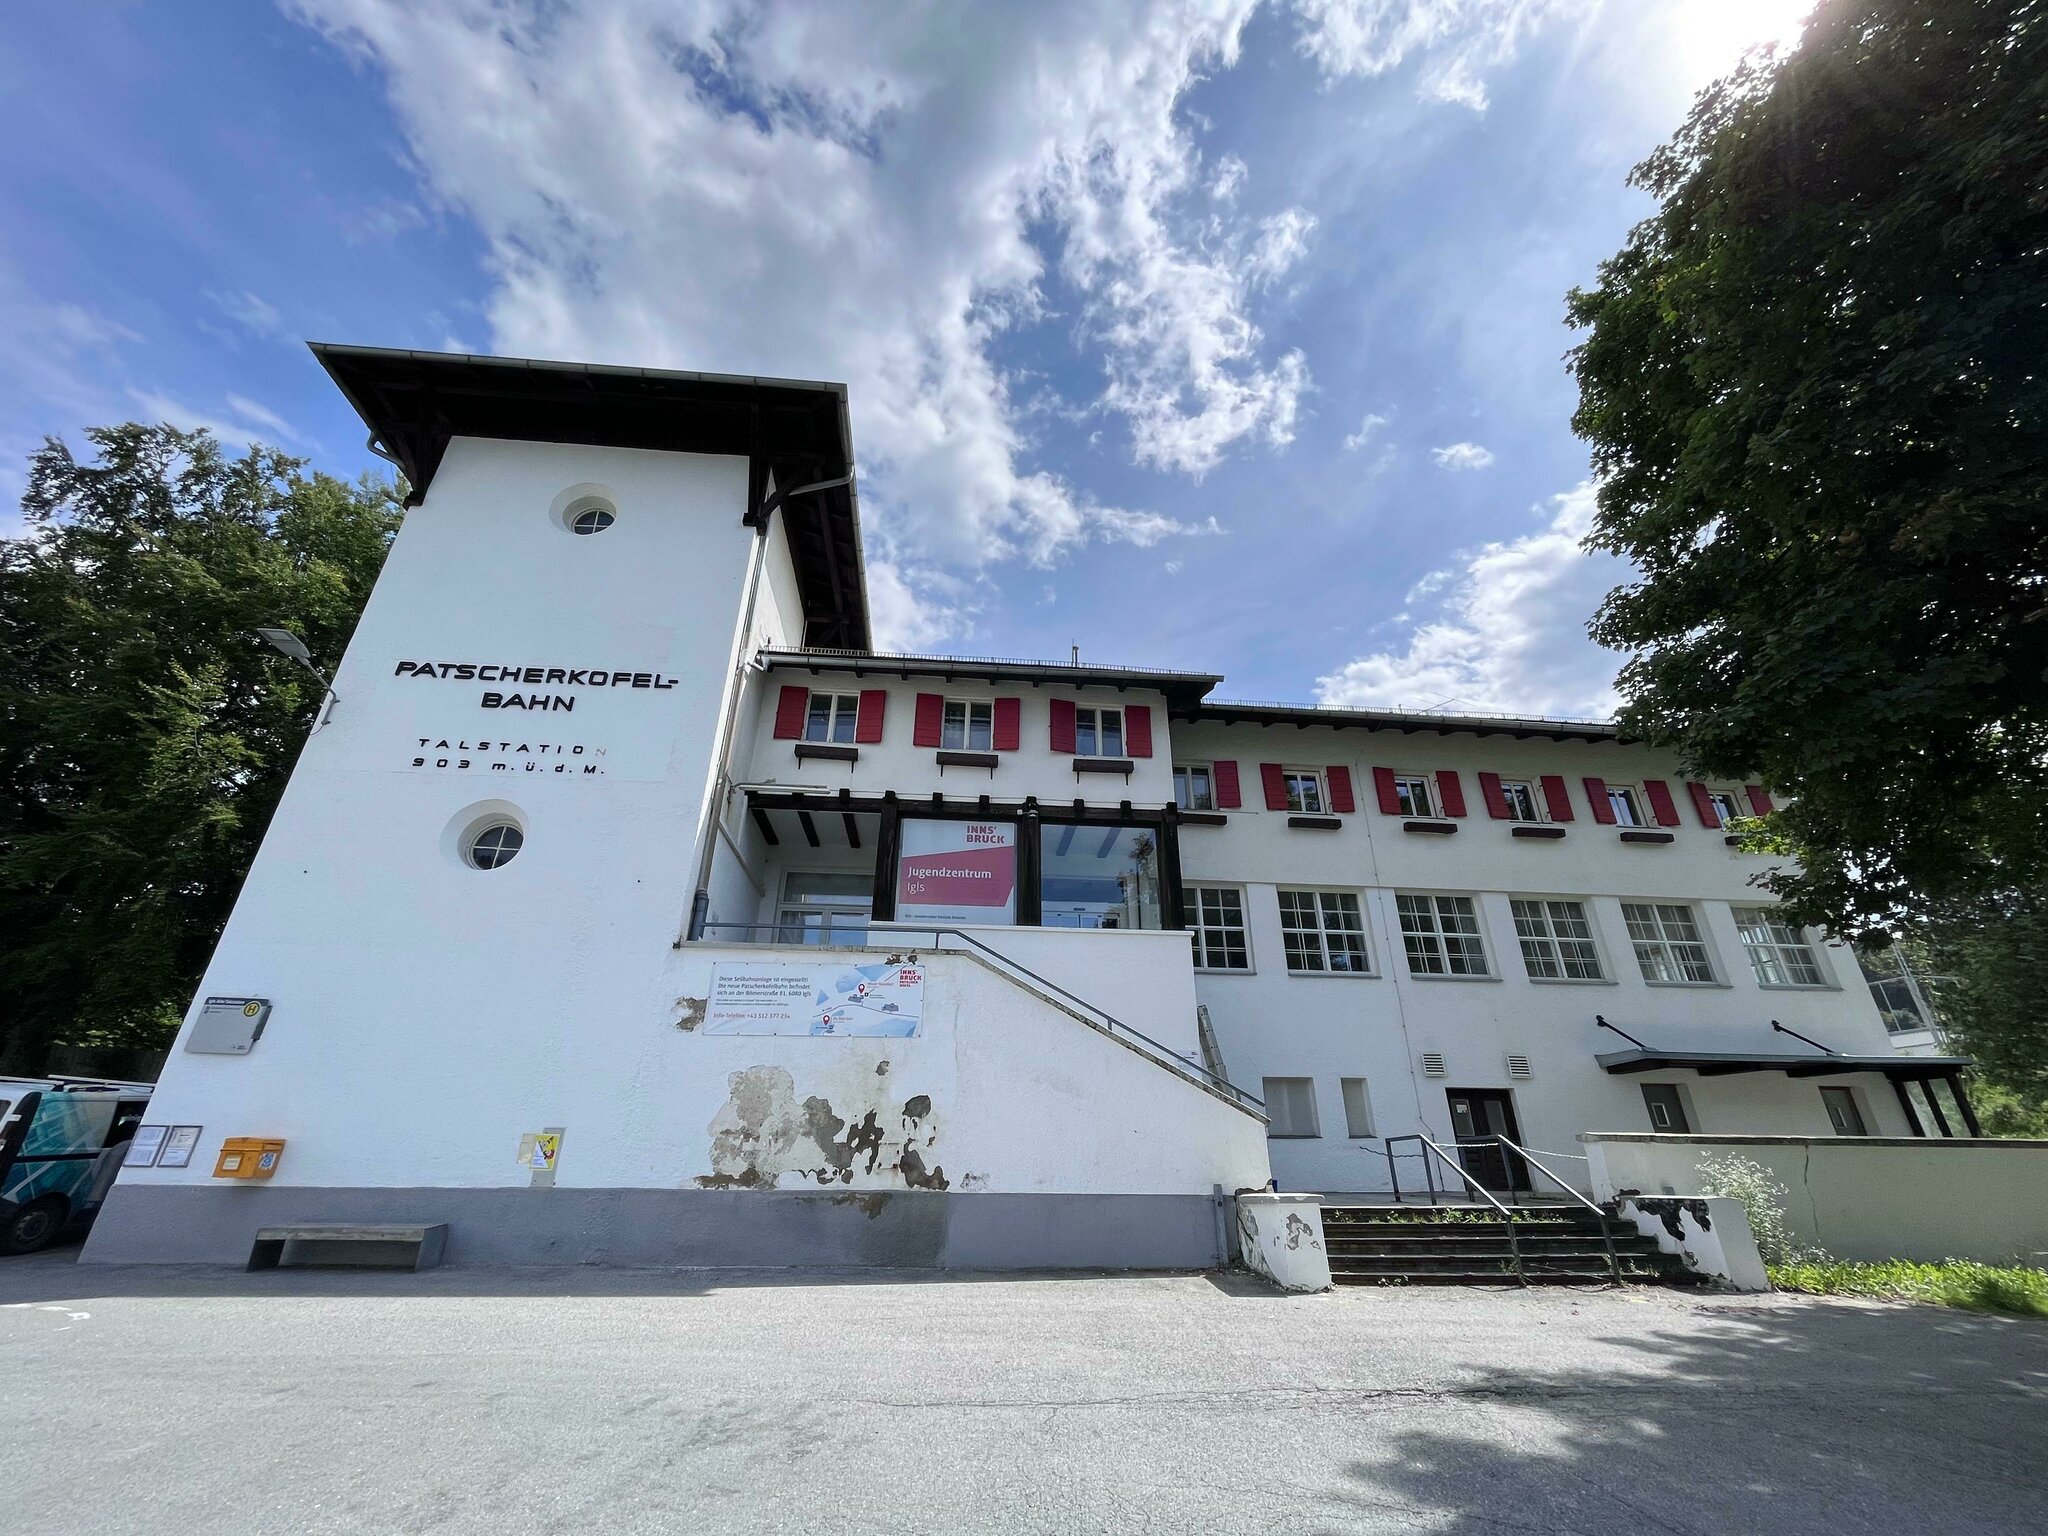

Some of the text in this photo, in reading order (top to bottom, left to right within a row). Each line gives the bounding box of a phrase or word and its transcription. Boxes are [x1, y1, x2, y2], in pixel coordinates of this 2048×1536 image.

[395, 661, 679, 689] PATSCHERKOFEL-
[481, 692, 575, 711] BAHN
[418, 738, 607, 756] TALSTATION
[412, 757, 470, 769] 903
[966, 834, 1005, 843] BRUCK
[908, 866, 992, 879] Jugendzentrum
[907, 881, 925, 894] Igls
[247, 1005, 257, 1014] H
